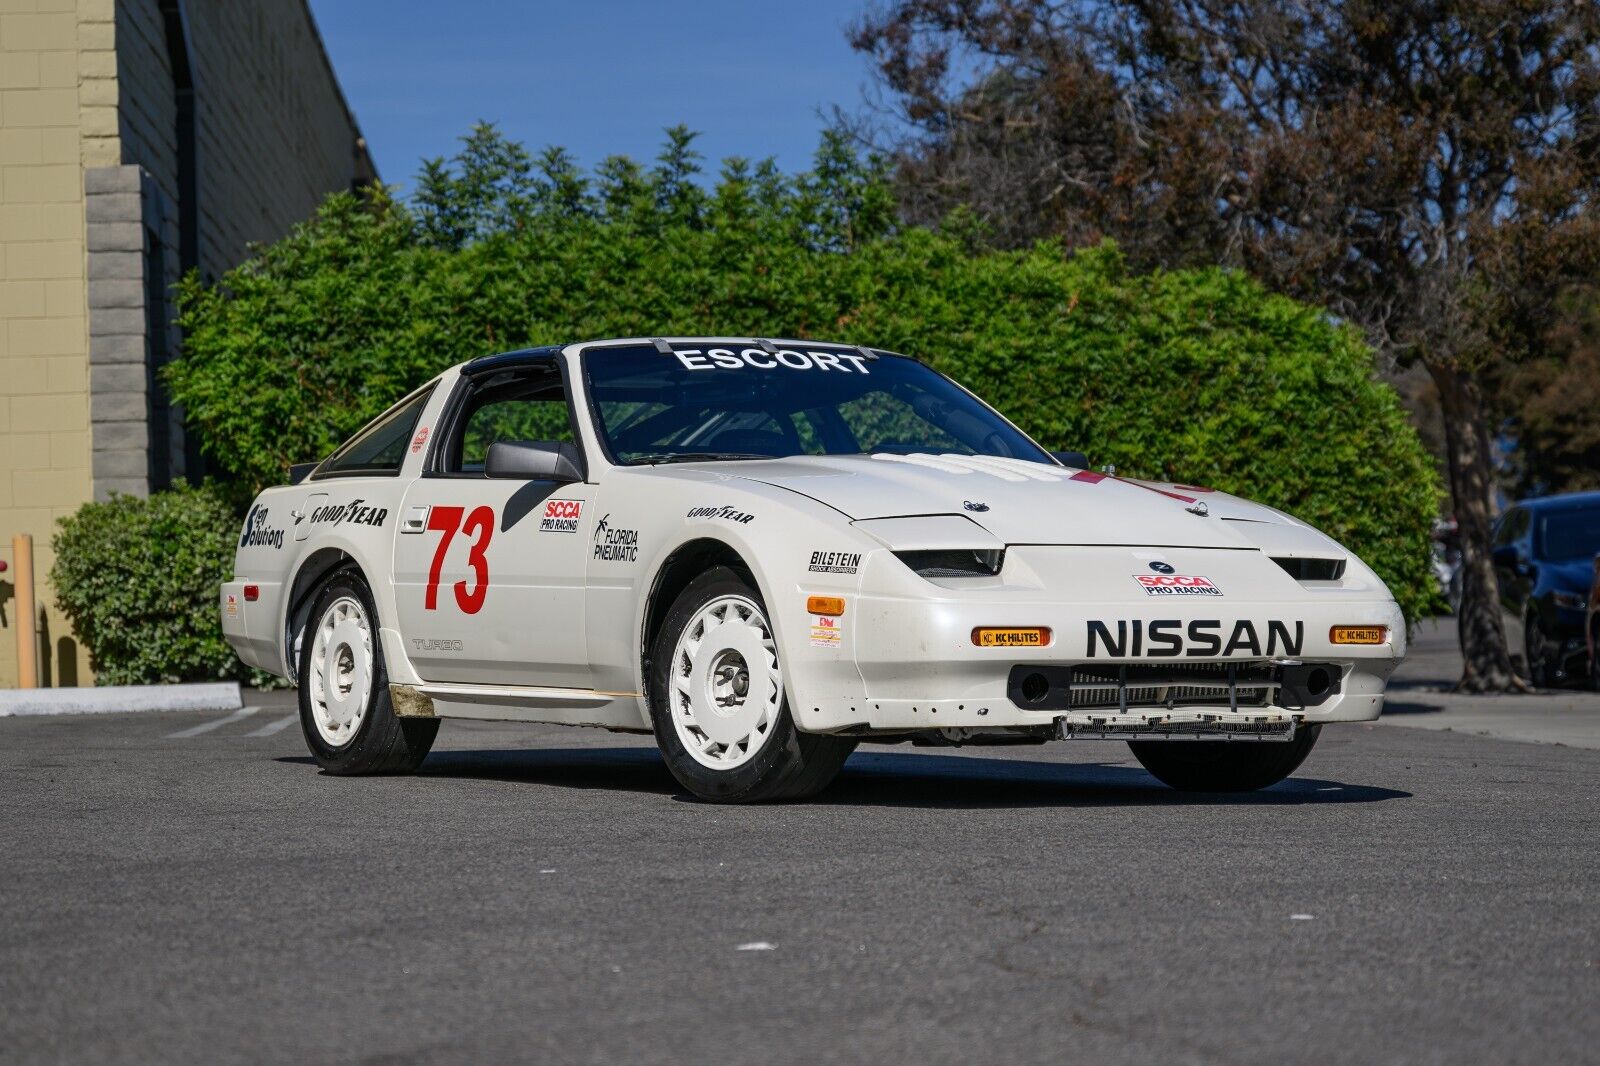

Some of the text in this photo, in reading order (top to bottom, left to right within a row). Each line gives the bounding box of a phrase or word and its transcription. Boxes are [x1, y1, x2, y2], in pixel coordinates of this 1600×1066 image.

[673, 348, 870, 374] ESCORT
[310, 499, 388, 527] GOODYEAR
[545, 501, 580, 518] SCCA
[687, 505, 755, 524] GOODYEAR
[541, 519, 578, 531] PRO RACING
[241, 523, 285, 549] Solutions
[605, 528, 638, 545] FLORIDA
[425, 505, 495, 615] 73
[593, 545, 638, 562] PNEUMATIC
[809, 551, 862, 567] BILSTEIN
[1137, 576, 1213, 587] SCCA
[1146, 586, 1220, 595] PRO RACING
[411, 638, 464, 651] TURBO
[995, 633, 1007, 643] KC
[1086, 619, 1304, 658] NISSAN
